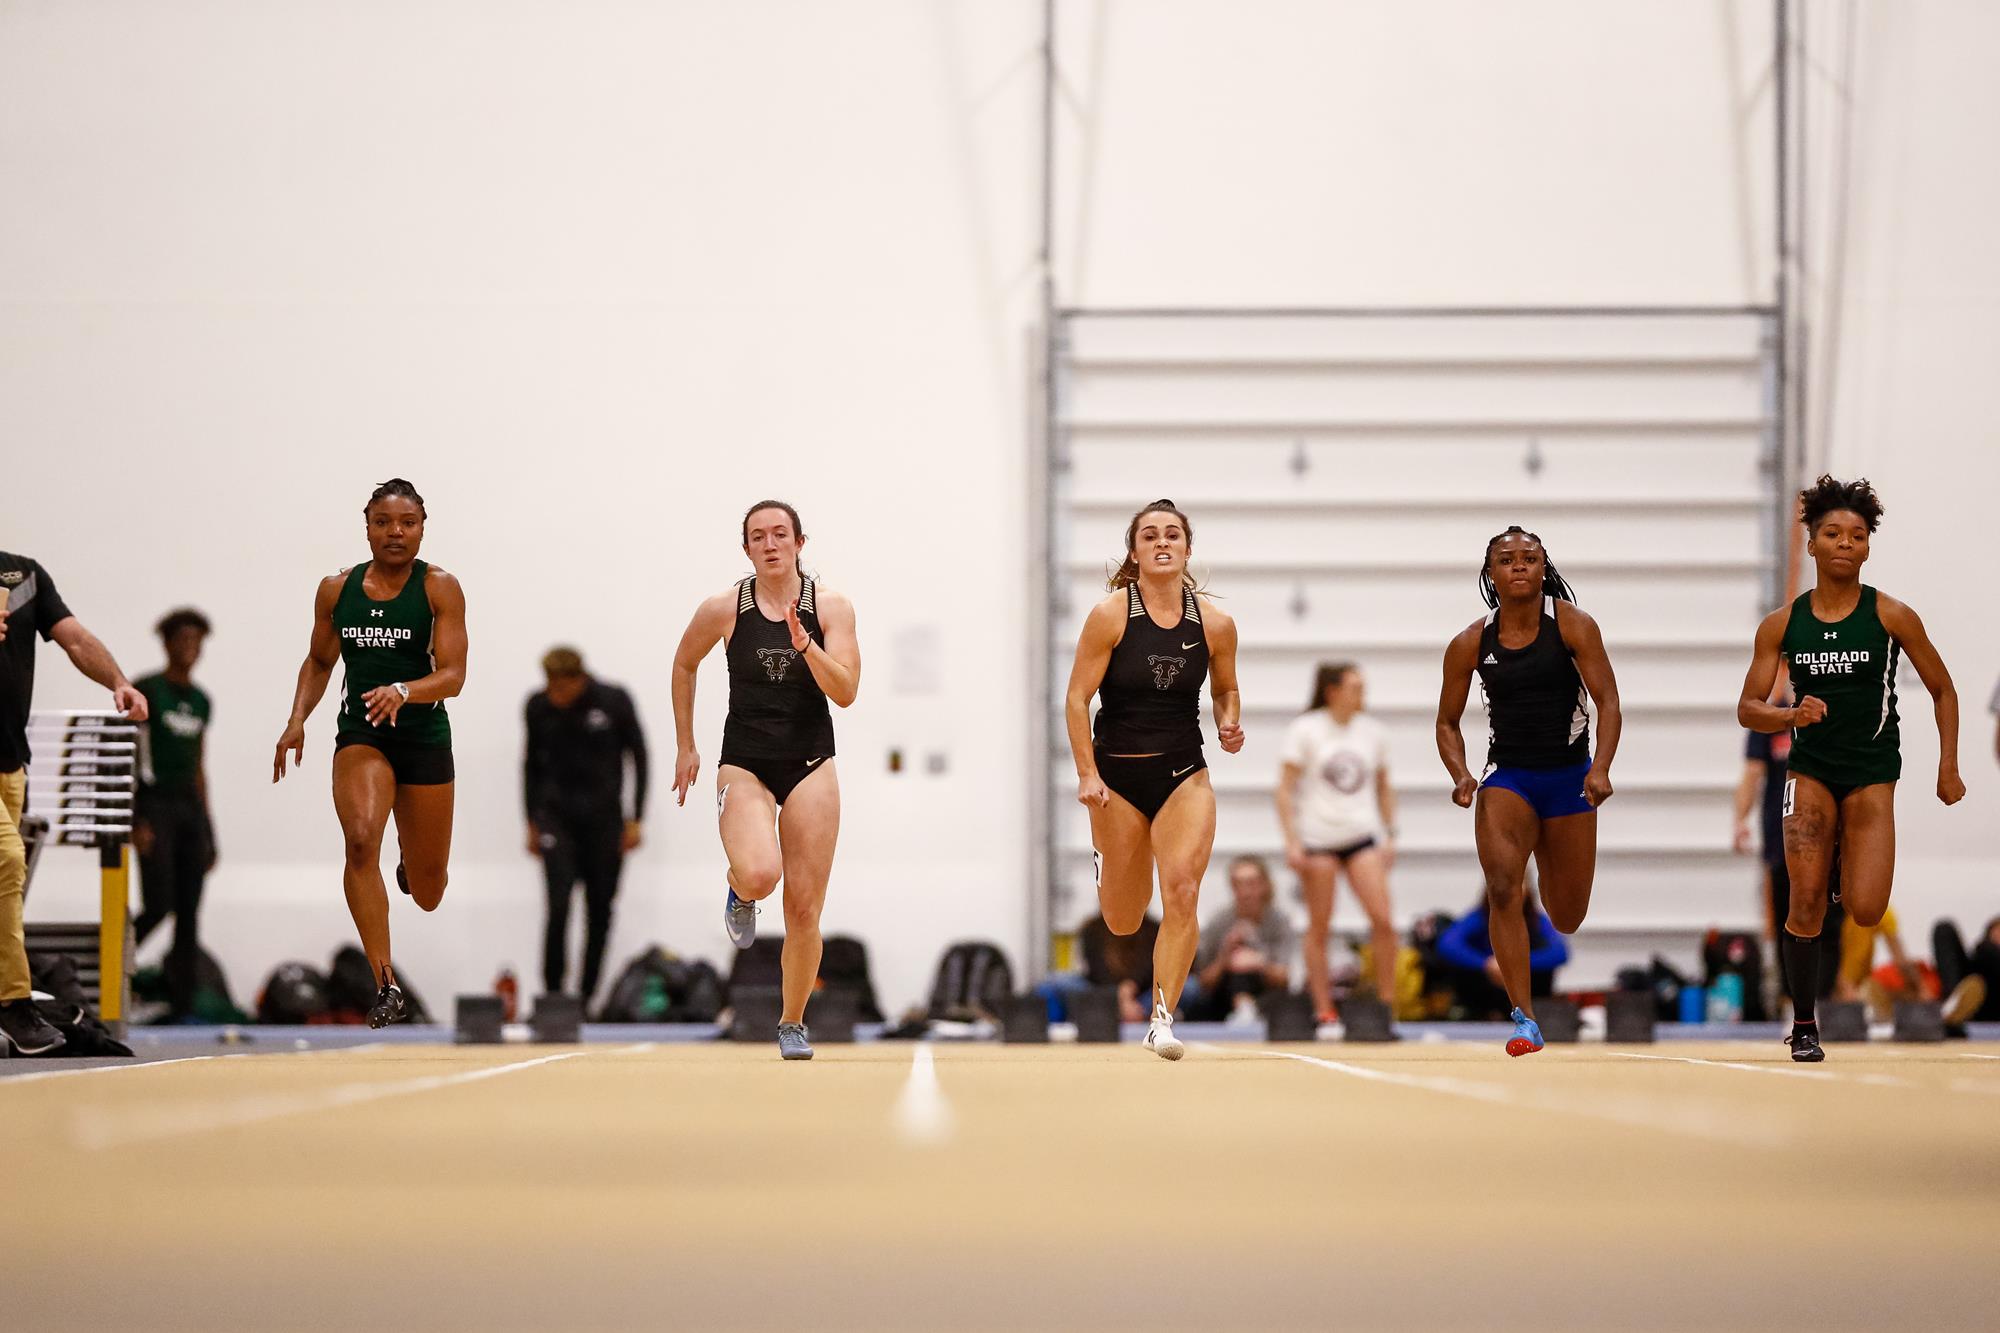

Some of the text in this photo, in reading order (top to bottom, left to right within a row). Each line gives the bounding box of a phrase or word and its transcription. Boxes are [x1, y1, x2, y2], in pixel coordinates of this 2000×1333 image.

[342, 627, 411, 640] COLORADO
[356, 638, 396, 649] STATE
[1795, 651, 1870, 665] COLORADO
[1809, 662, 1853, 675] STATE
[1784, 782, 1791, 813] 4
